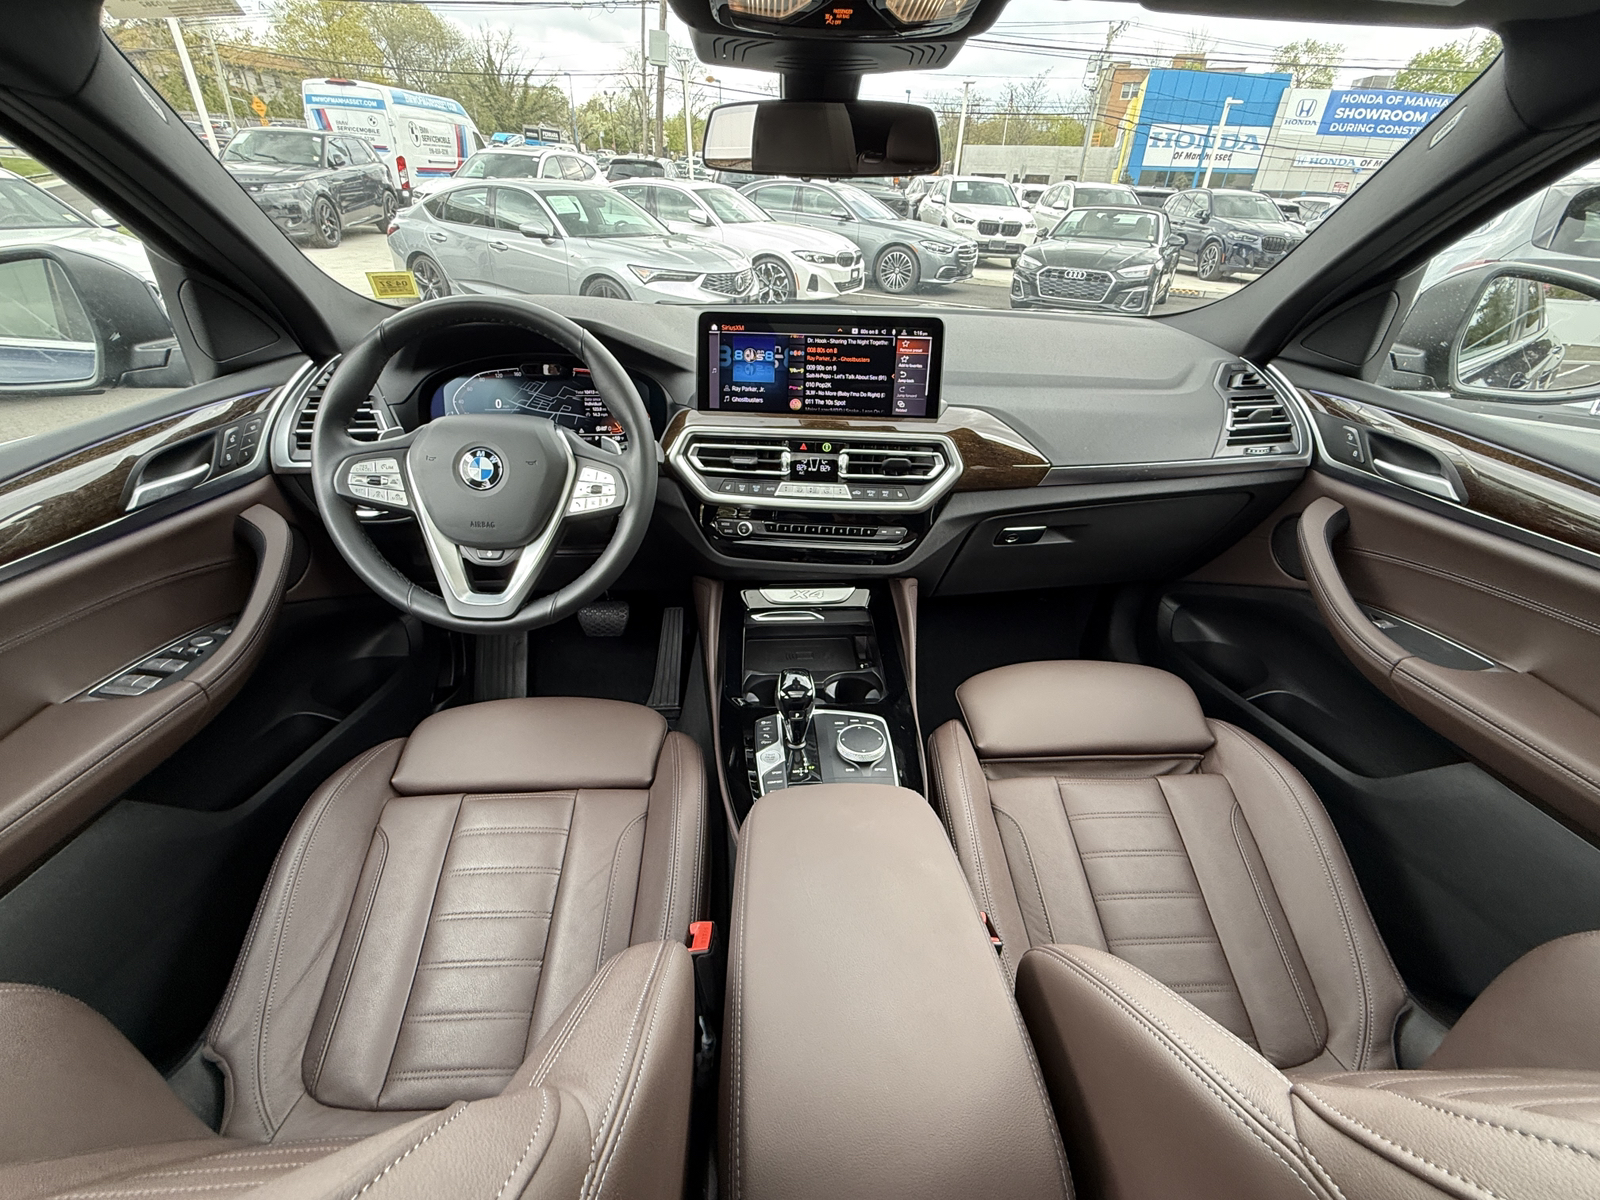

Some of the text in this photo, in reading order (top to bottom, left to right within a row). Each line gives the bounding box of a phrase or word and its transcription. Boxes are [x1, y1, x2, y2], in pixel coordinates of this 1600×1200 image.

[1340, 94, 1383, 105] HONDA
[1386, 96, 1403, 105] OF
[1334, 108, 1429, 122] SHOWROOM
[1329, 122, 1374, 132] DURING
[1148, 132, 1262, 151] HONDA
[1308, 157, 1356, 166] HONDA
[495, 399, 502, 409] 0
[466, 450, 498, 464] BMW
[790, 590, 824, 600] X4
